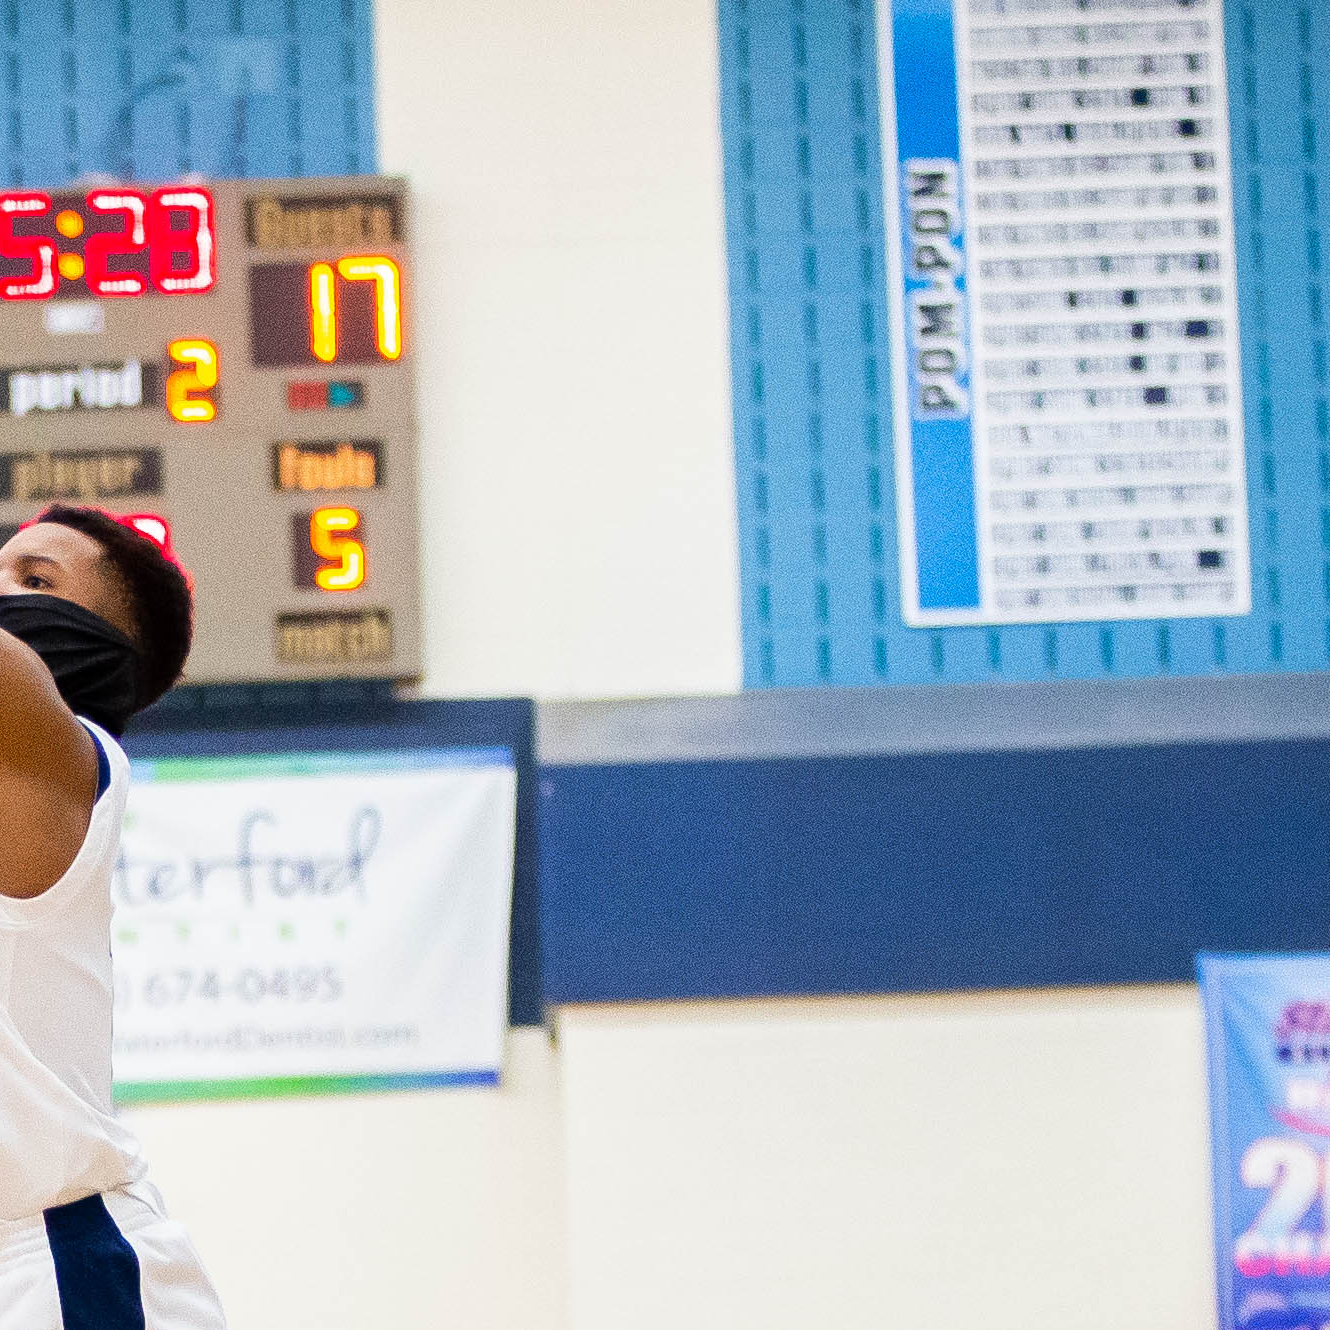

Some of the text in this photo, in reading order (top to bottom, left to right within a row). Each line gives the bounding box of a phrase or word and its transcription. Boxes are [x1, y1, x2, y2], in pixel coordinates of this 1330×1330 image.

[308, 254, 403, 364] 17
[165, 337, 219, 423] 2
[309, 505, 367, 592] 5
